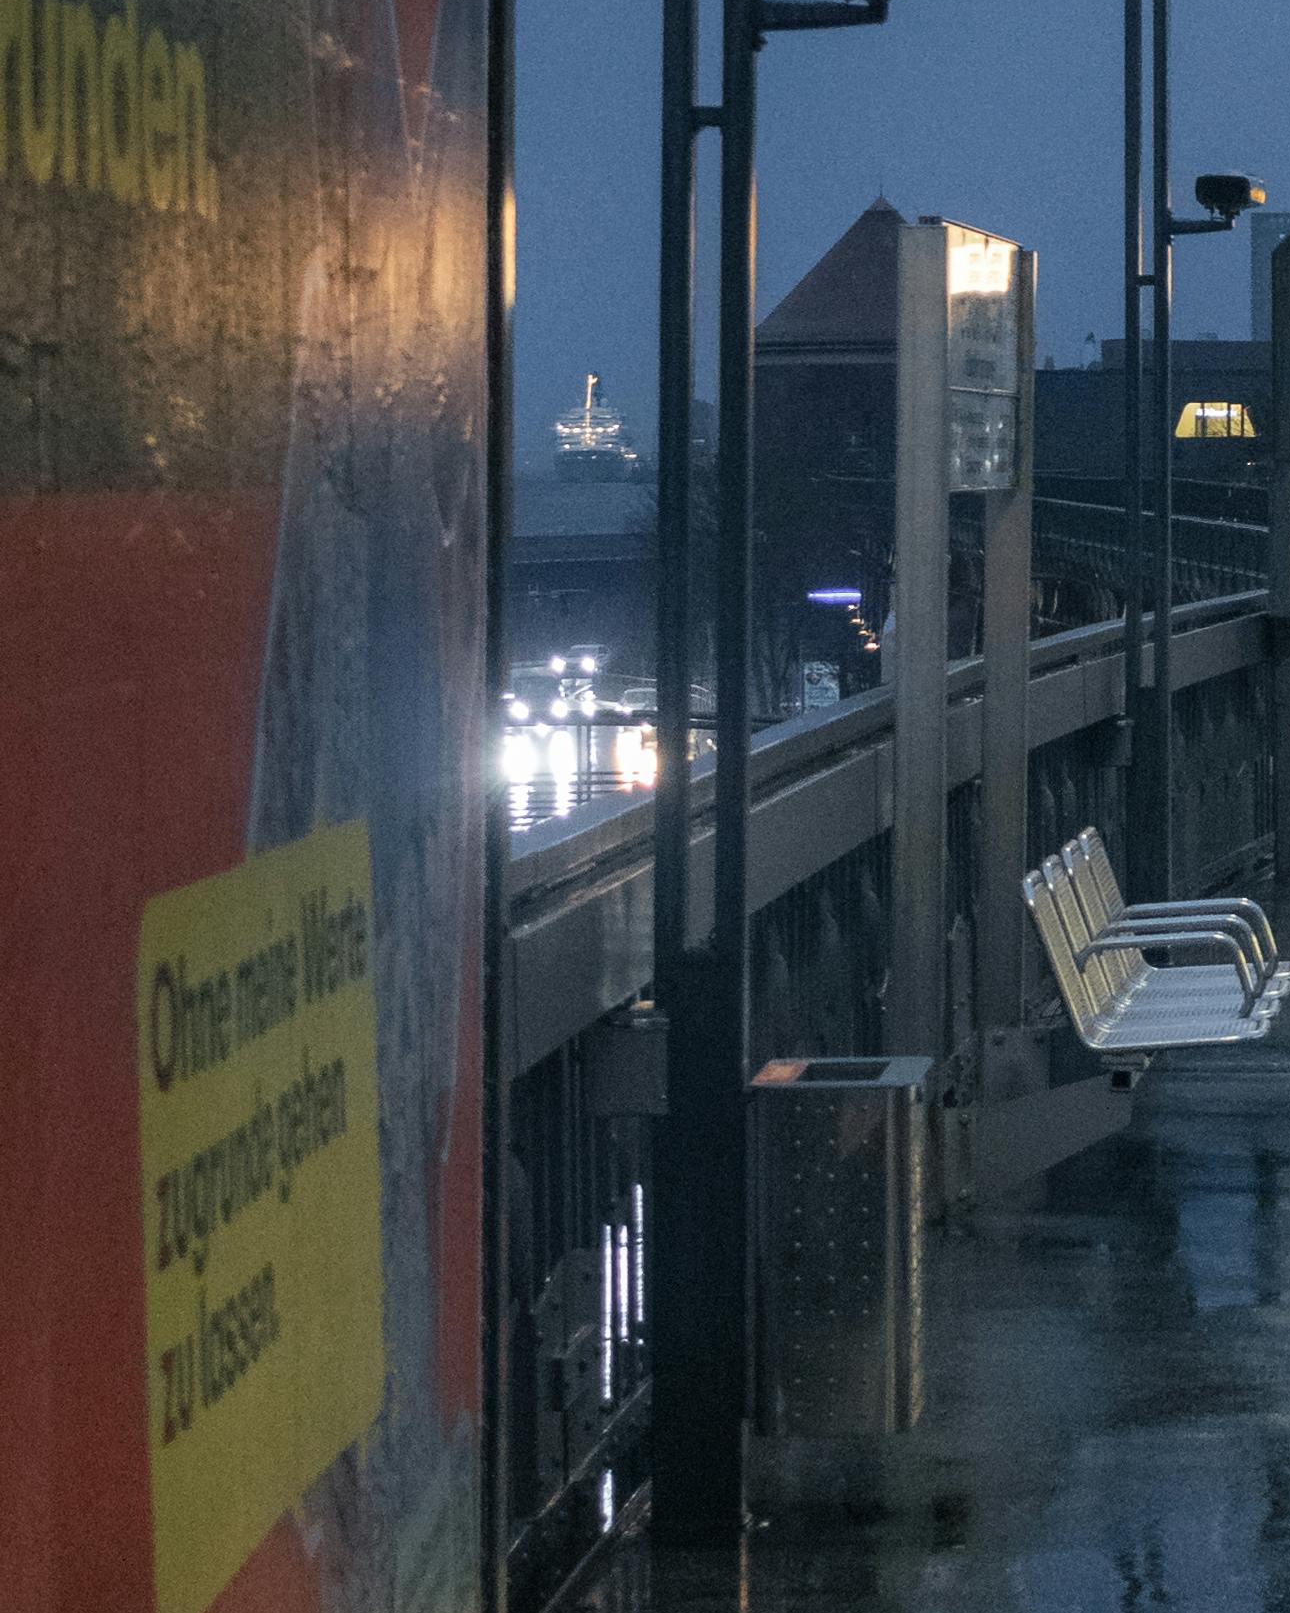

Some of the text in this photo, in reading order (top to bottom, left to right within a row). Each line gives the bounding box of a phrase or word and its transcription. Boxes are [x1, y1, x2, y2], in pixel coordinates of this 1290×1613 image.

[150, 953, 231, 1091] Ohne
[278, 1044, 347, 1204] gehen
[161, 1334, 195, 1445] zu
